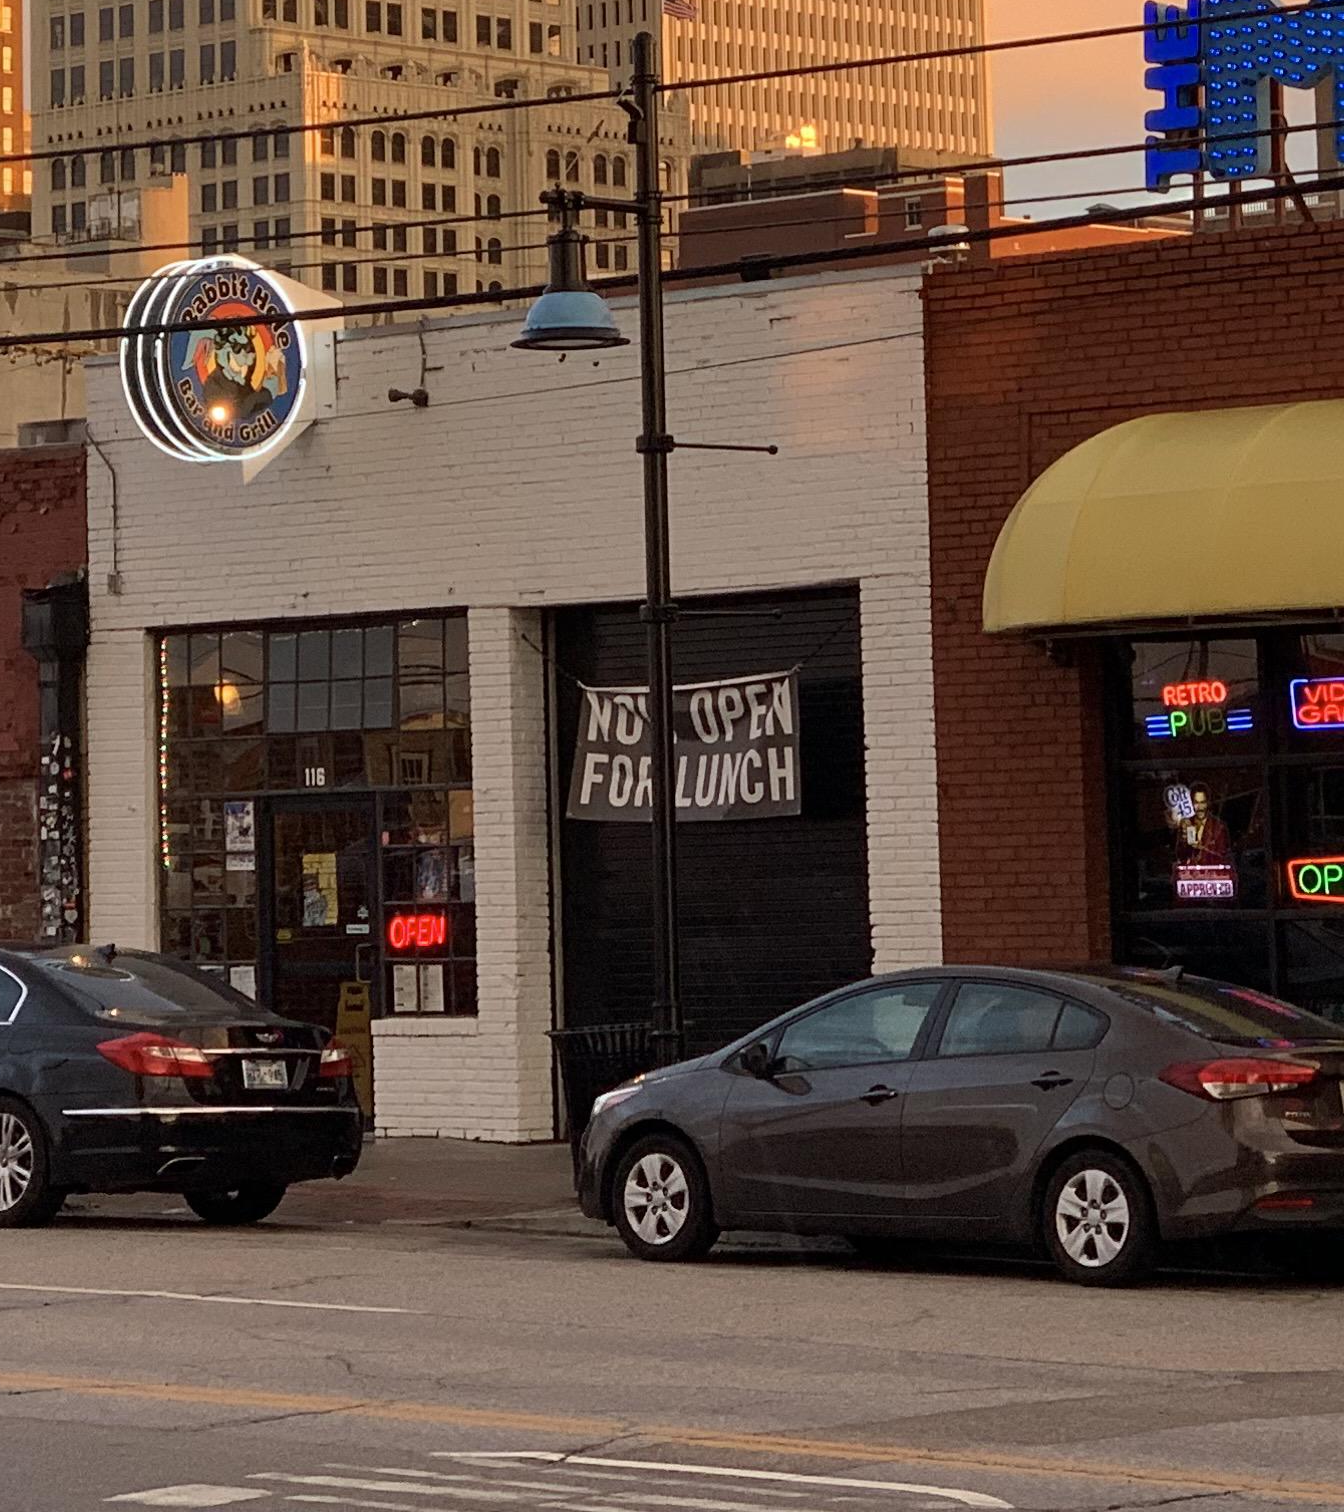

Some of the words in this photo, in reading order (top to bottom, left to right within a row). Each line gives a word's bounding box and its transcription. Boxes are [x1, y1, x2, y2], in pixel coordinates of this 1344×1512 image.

[177, 376, 205, 417] Bar
[239, 407, 278, 443] Grill
[1162, 681, 1227, 706] RETRO
[690, 677, 794, 744] OPEN
[1169, 708, 1226, 737] PUB
[304, 767, 325, 786] 116
[674, 746, 795, 807] LUNCH
[1165, 786, 1189, 808] Colt
[390, 914, 446, 948] OPEN
